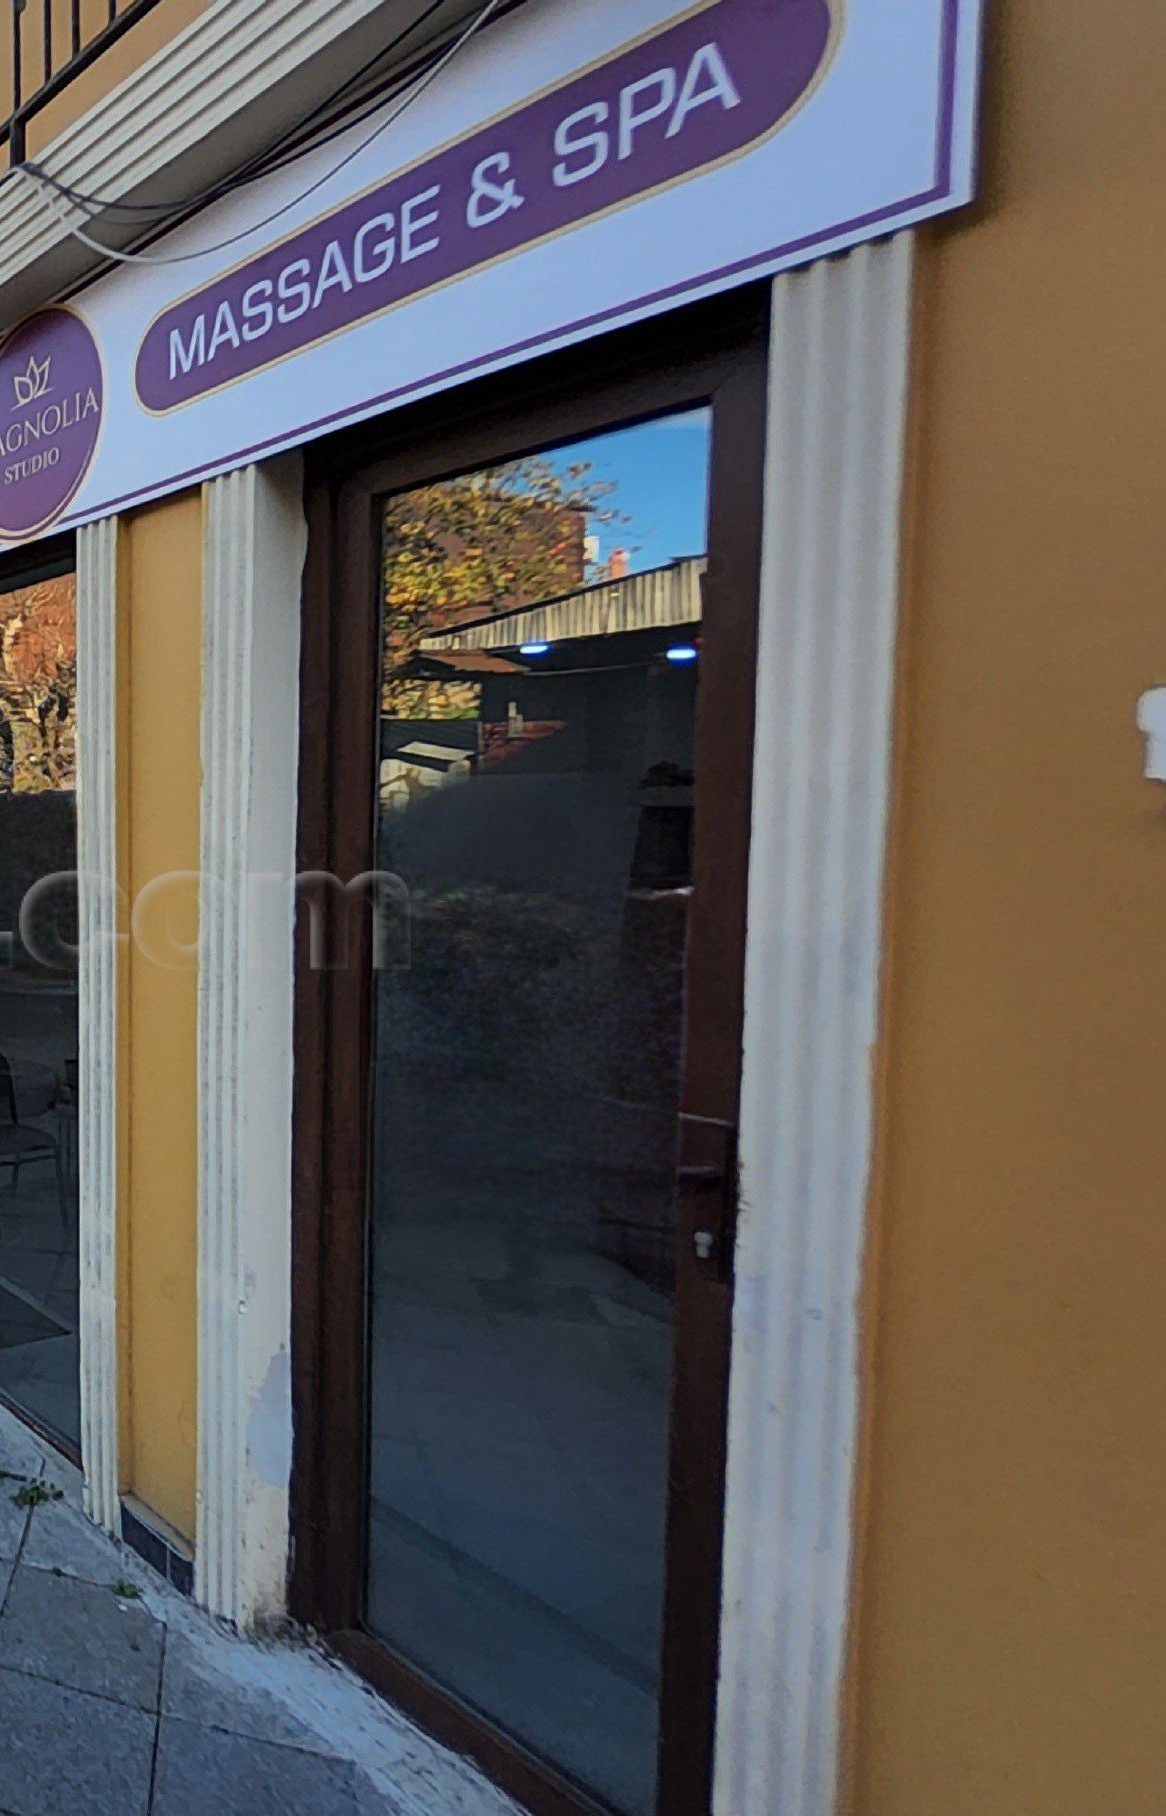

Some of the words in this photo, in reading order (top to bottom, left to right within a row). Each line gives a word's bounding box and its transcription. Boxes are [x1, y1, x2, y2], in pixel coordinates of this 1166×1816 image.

[168, 184, 441, 381] MASSAGE
[466, 151, 525, 229] &
[552, 42, 742, 188] SPA
[3, 446, 61, 485] STUDIO
